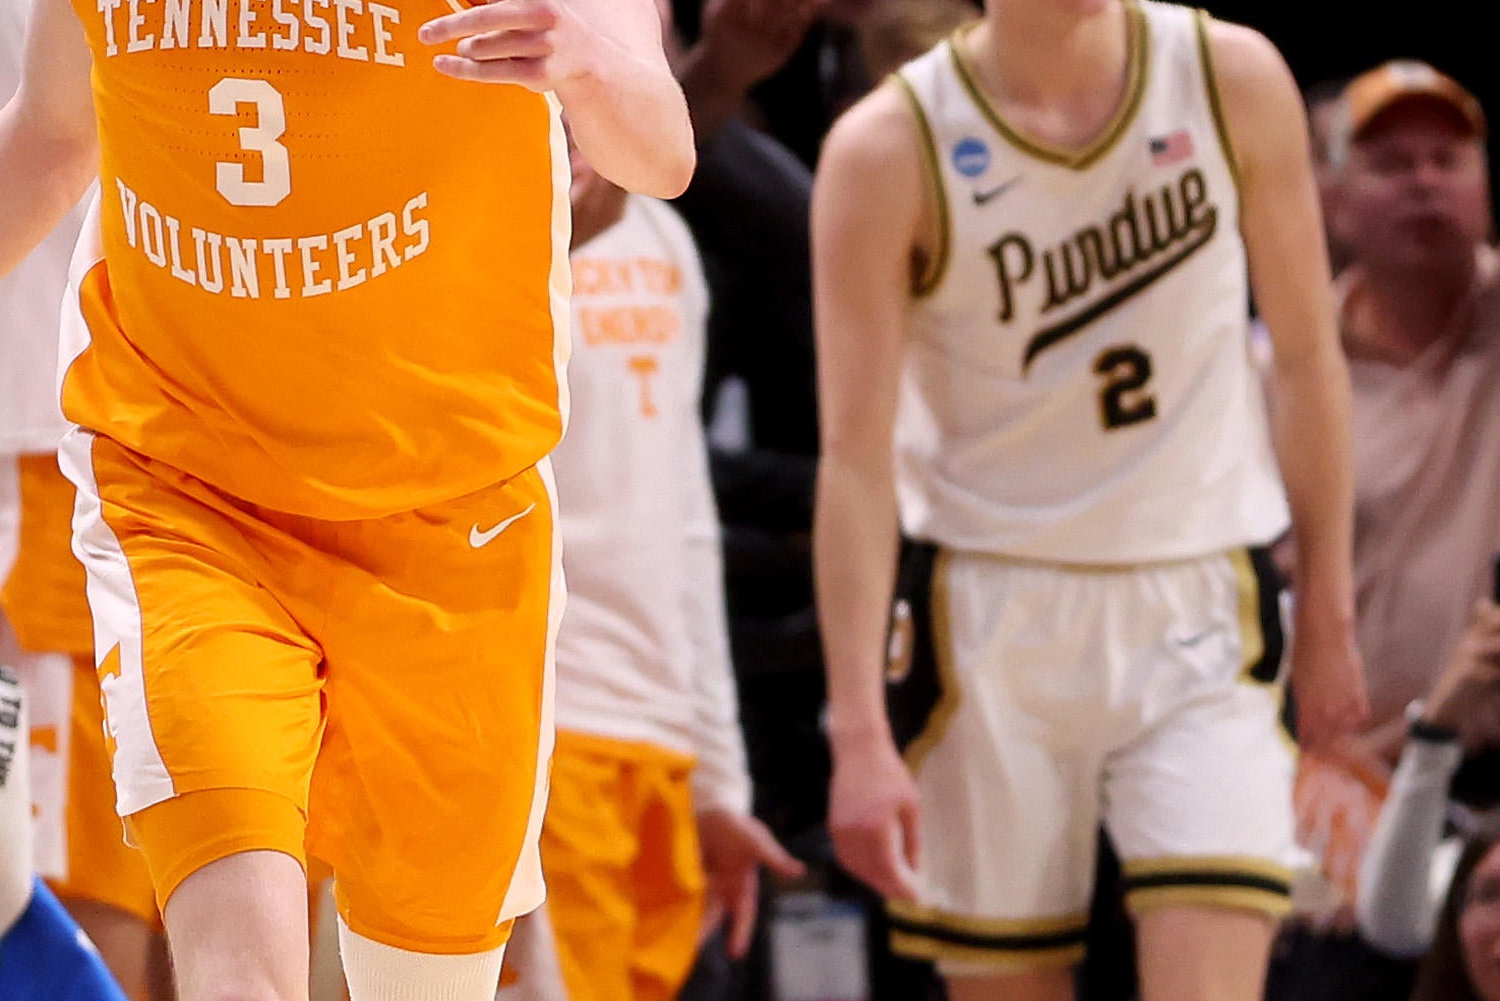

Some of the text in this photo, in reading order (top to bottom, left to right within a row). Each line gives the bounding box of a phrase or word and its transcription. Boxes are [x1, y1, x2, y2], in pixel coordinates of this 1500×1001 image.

[208, 77, 291, 207] 3
[115, 176, 430, 299] VOLUNTEERS
[987, 167, 1217, 352] Purdue
[1094, 343, 1157, 431] 2
